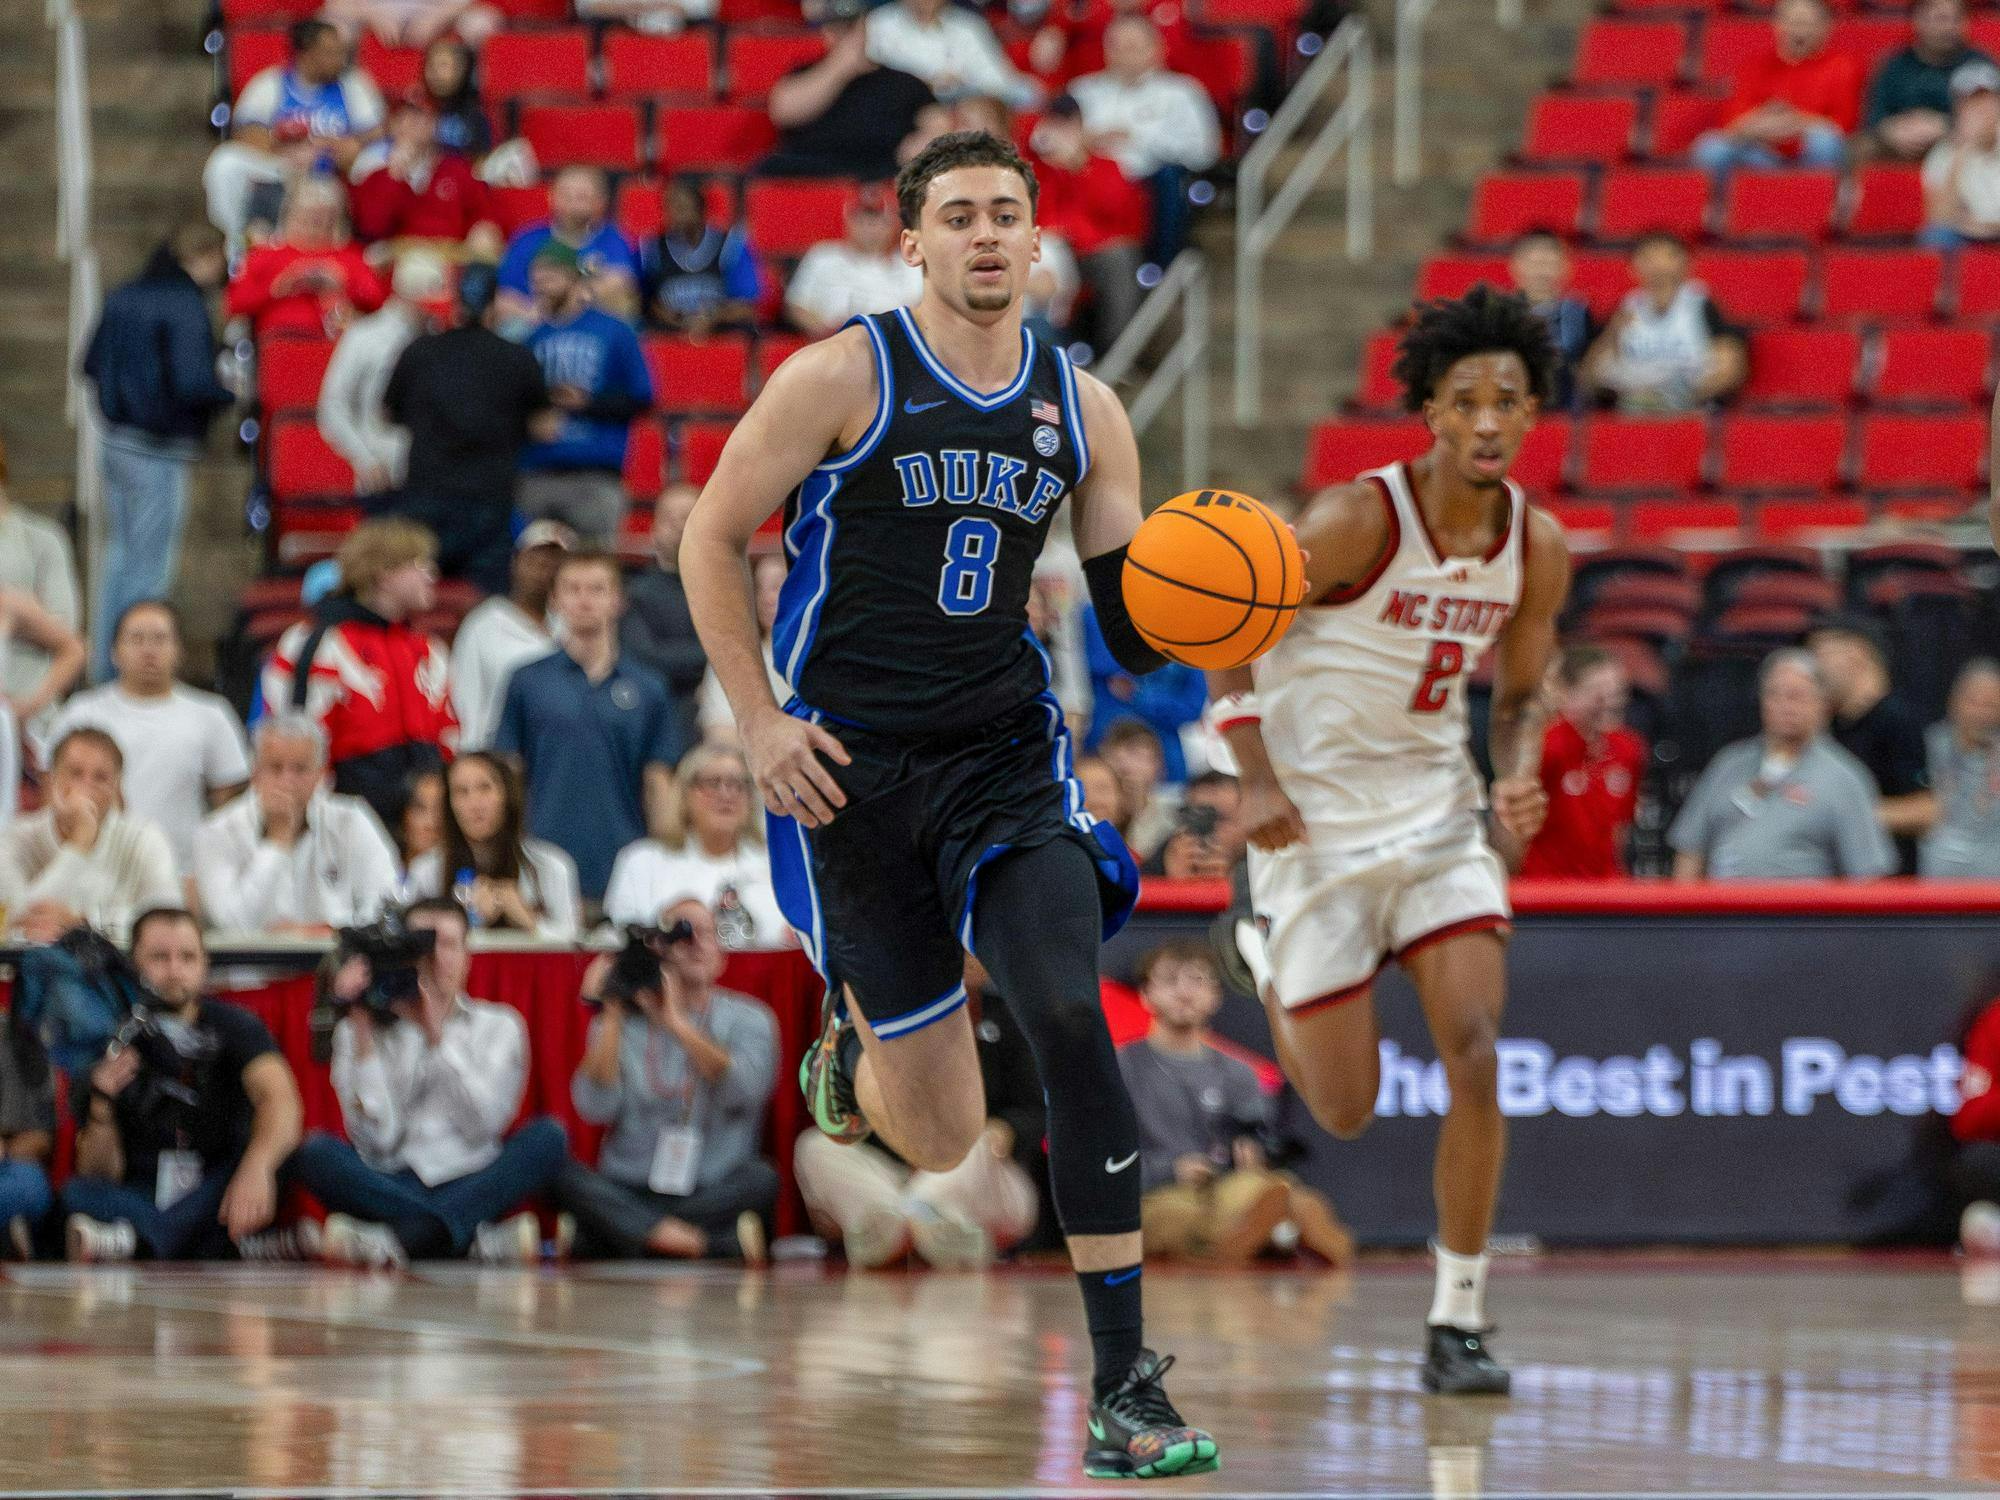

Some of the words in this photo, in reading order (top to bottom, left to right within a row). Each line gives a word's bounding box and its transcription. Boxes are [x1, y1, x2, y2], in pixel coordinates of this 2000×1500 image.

[893, 449, 1065, 524] DUKE
[937, 516, 1001, 616] 8
[1380, 590, 1429, 630] NC
[1411, 641, 1463, 712] 2
[1495, 1038, 1686, 1117] Best
[1690, 1037, 1775, 1117] in
